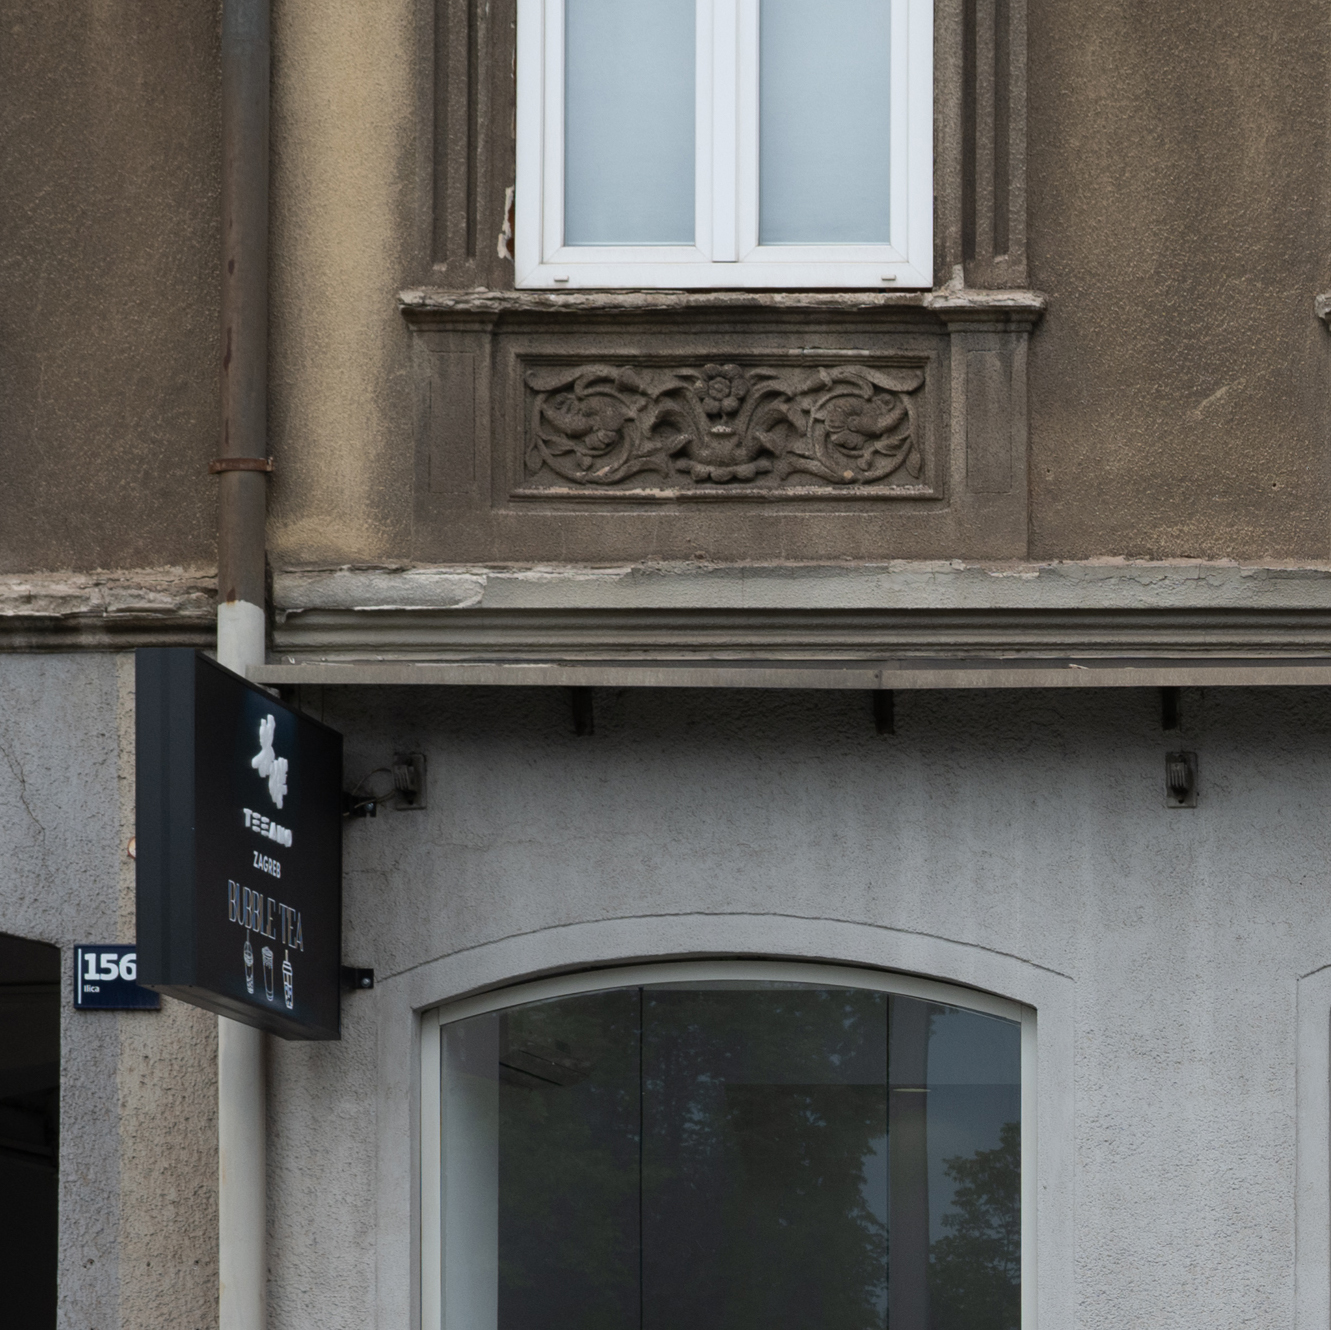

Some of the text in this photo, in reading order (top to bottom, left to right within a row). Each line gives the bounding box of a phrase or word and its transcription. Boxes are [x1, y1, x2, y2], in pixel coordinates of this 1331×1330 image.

[253, 851, 282, 879] ZAGREB
[227, 879, 304, 952] BUBBLE TEA
[83, 952, 136, 981] 156
[83, 984, 100, 993] Ilica
